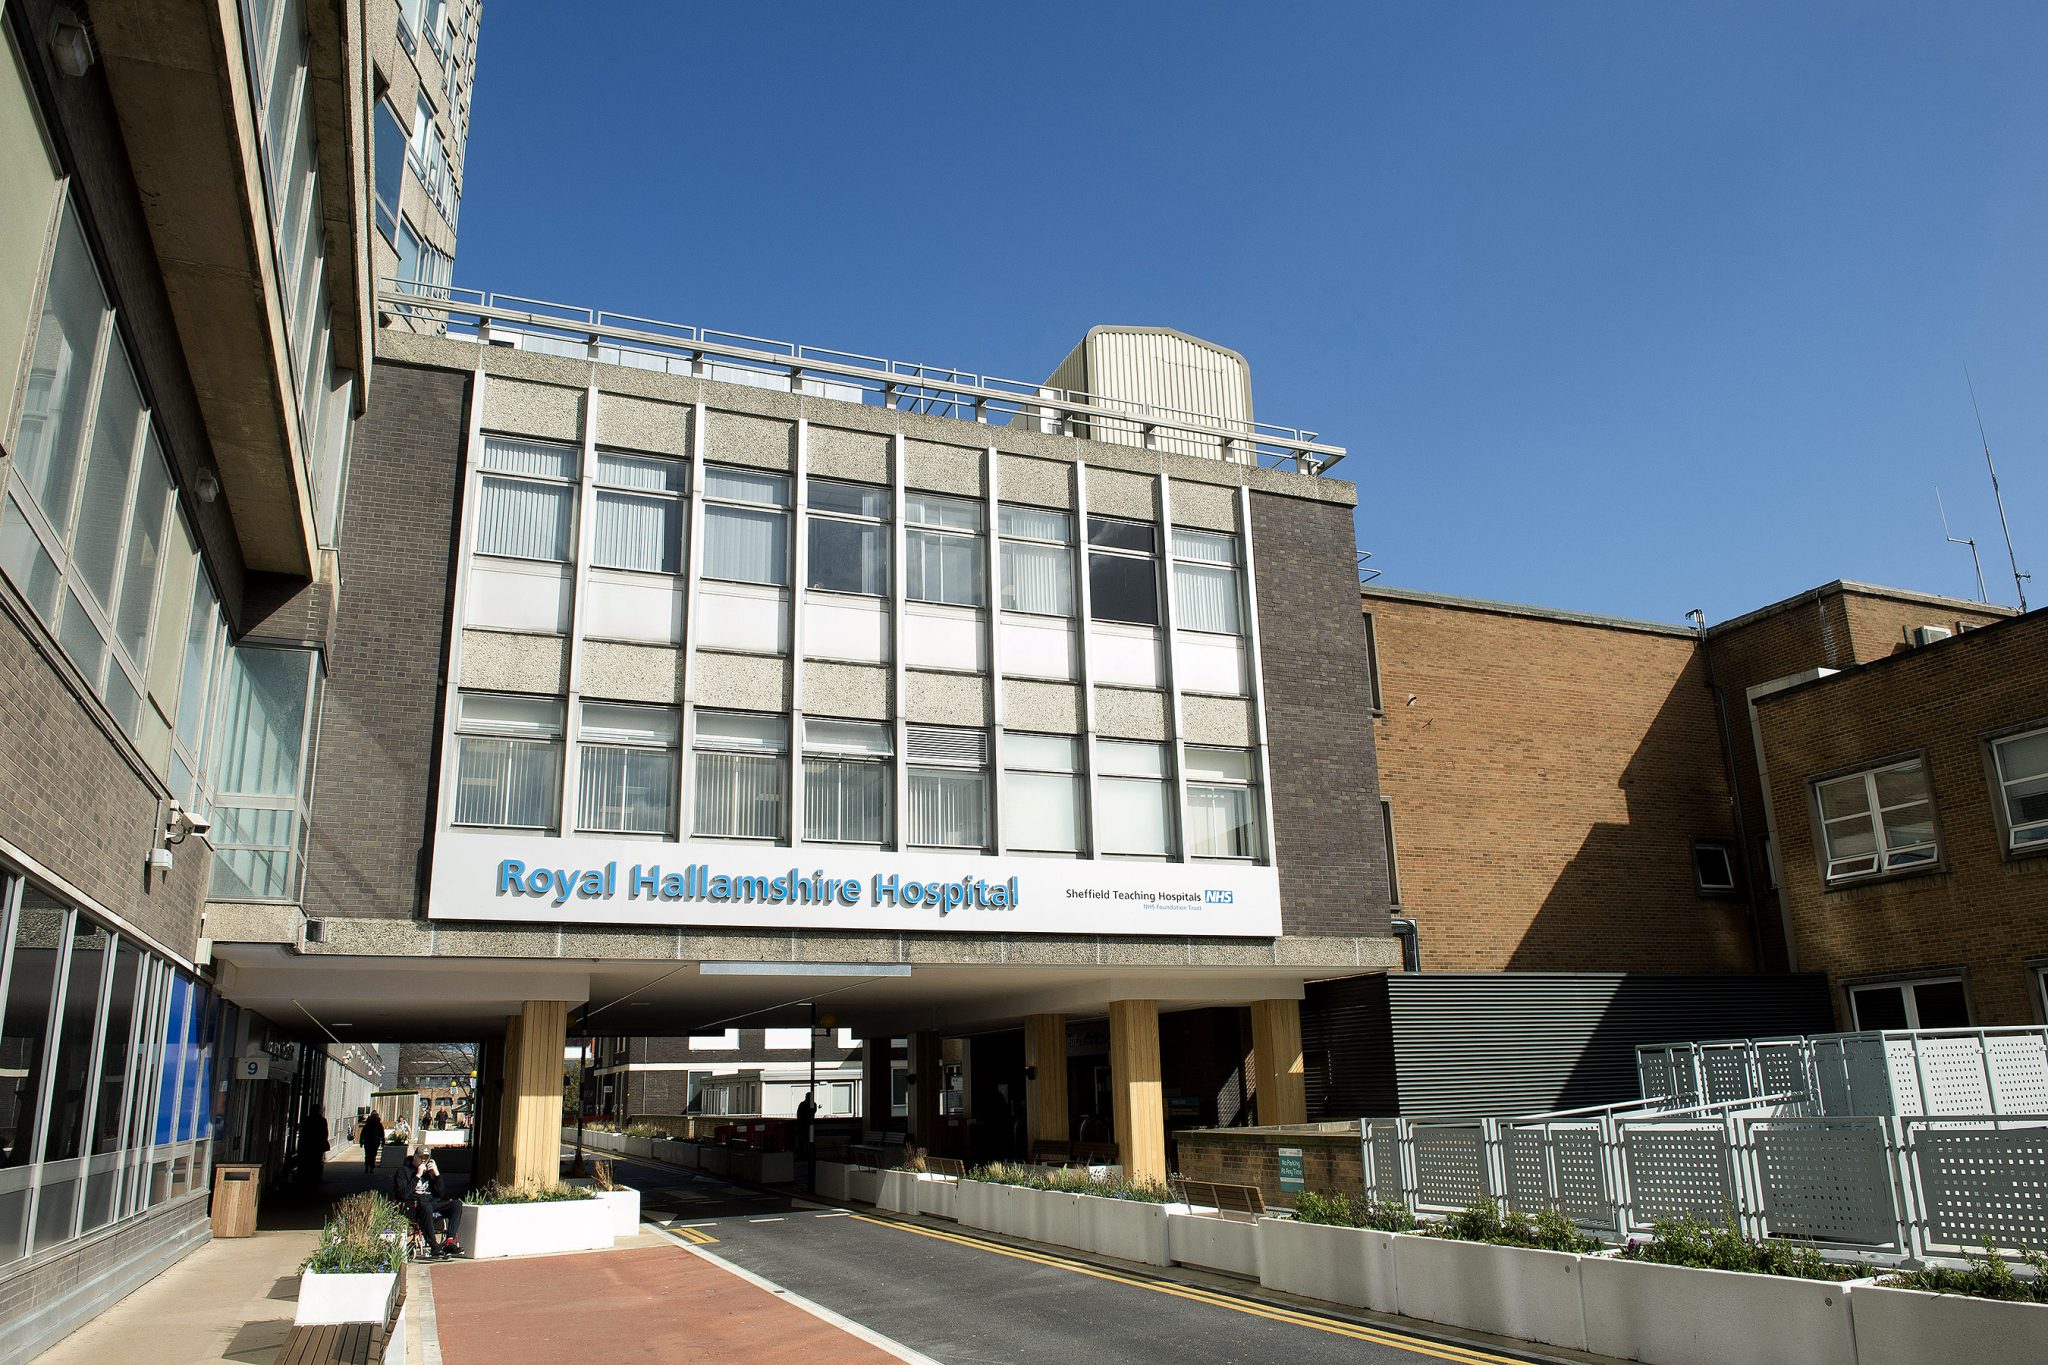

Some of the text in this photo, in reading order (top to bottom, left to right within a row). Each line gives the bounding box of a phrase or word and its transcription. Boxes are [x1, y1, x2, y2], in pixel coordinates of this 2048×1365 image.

[497, 859, 1019, 917] Royal Hallamshire Hospital
[1066, 888, 1233, 904] Sheffield Teaching Hospitals NHS
[247, 1061, 258, 1075] 9
[1287, 1159, 1300, 1168] Parking
